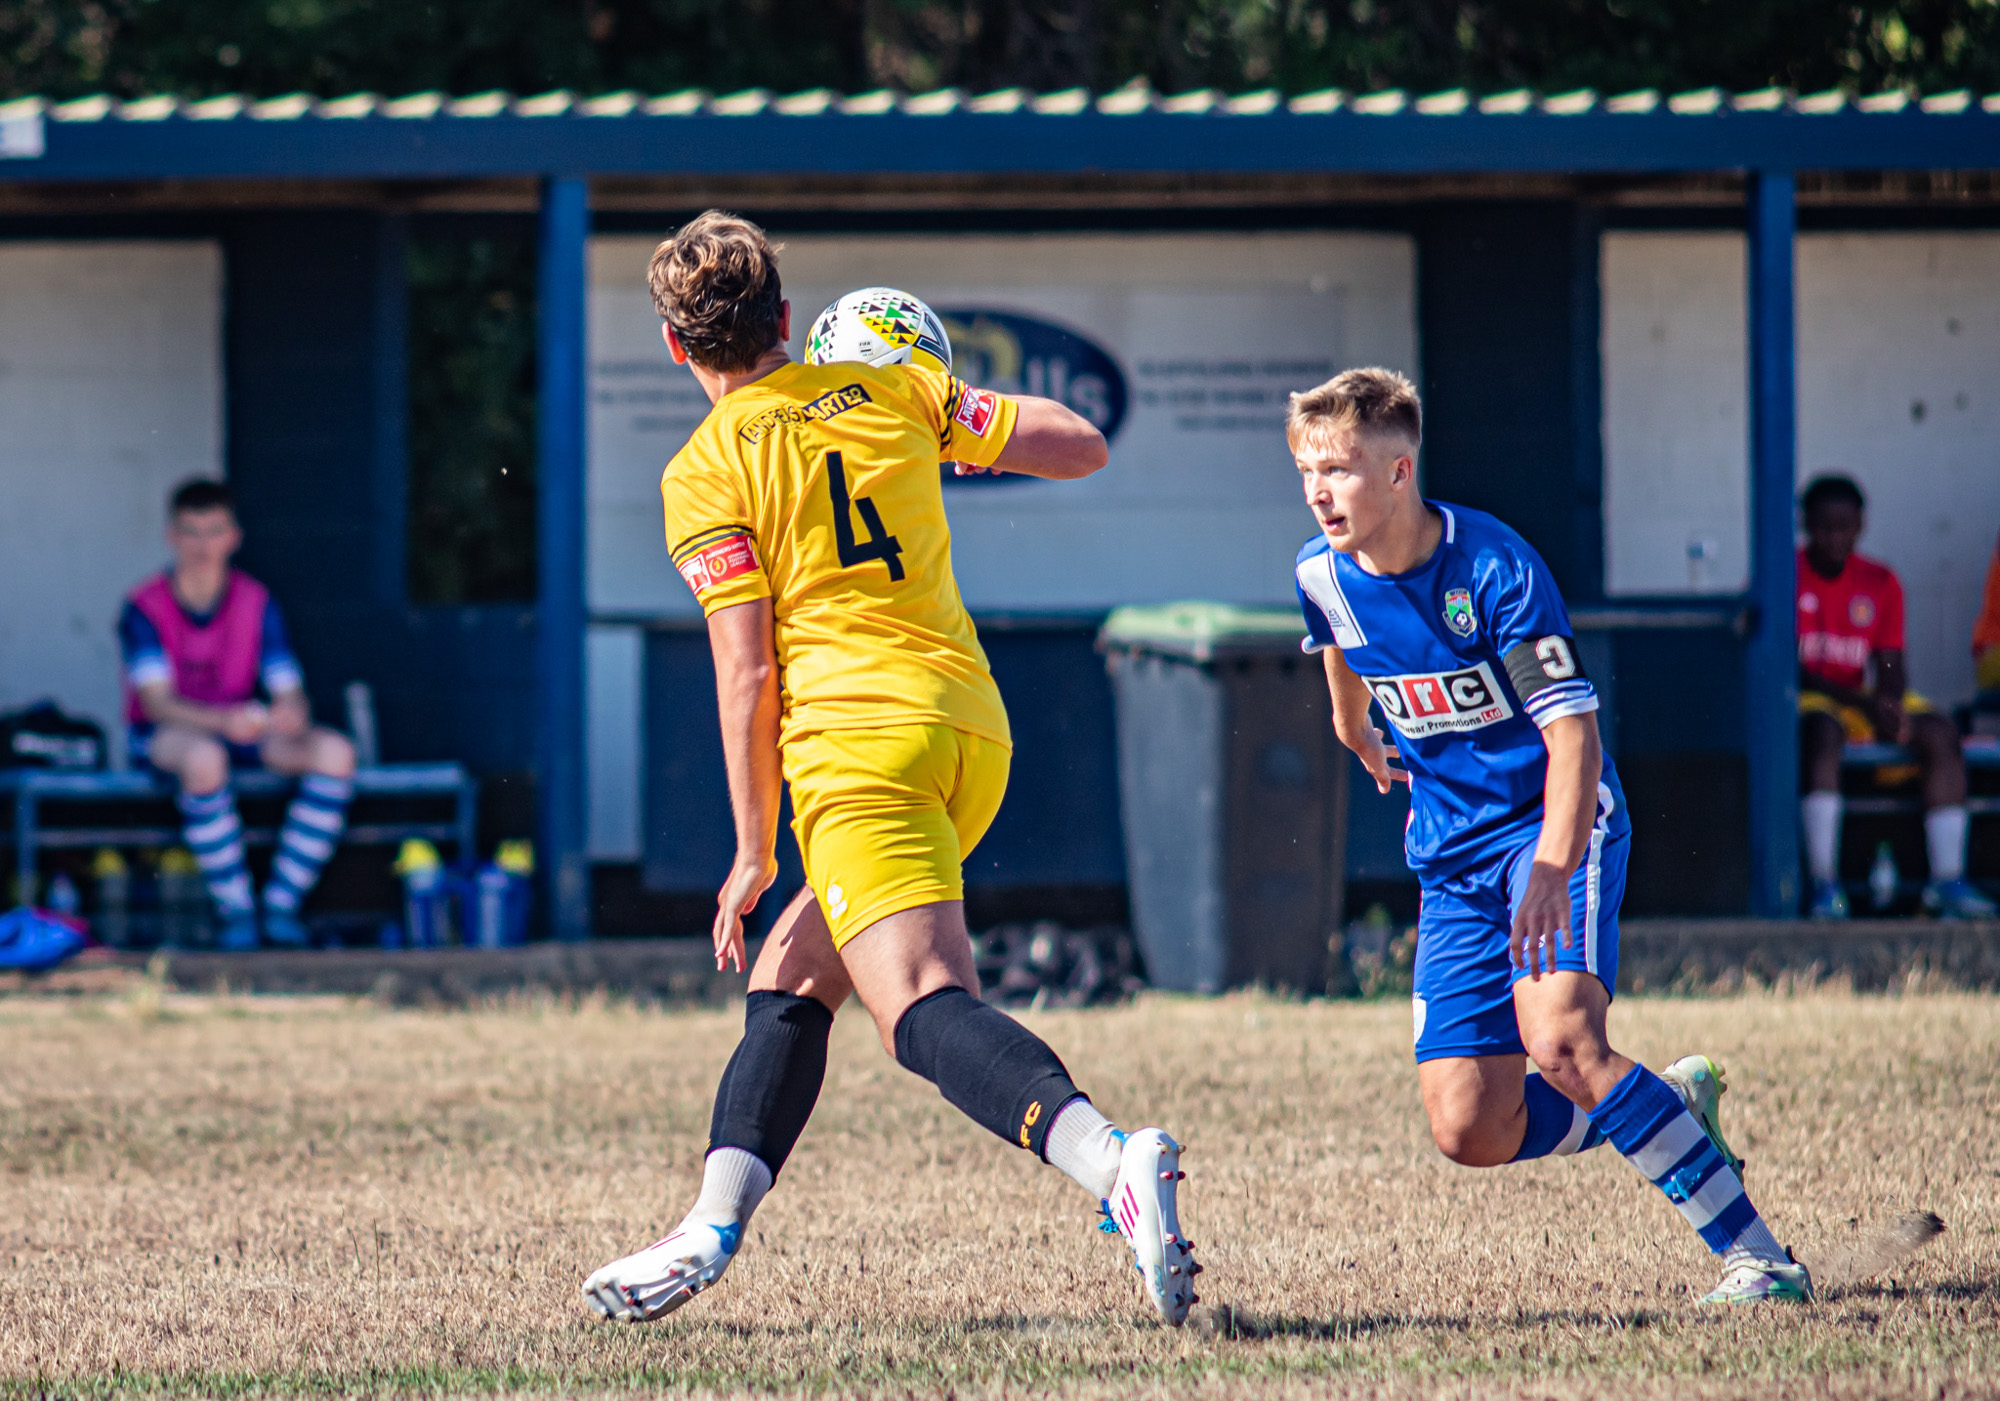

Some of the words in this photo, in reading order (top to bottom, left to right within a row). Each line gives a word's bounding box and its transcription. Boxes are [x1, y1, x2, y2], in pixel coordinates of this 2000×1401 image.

[803, 387, 863, 420] ARTER
[826, 450, 905, 582] 4
[1375, 676, 1485, 716] orc
[1427, 716, 1482, 731] Promotions
[1484, 708, 1501, 721] Ltd
